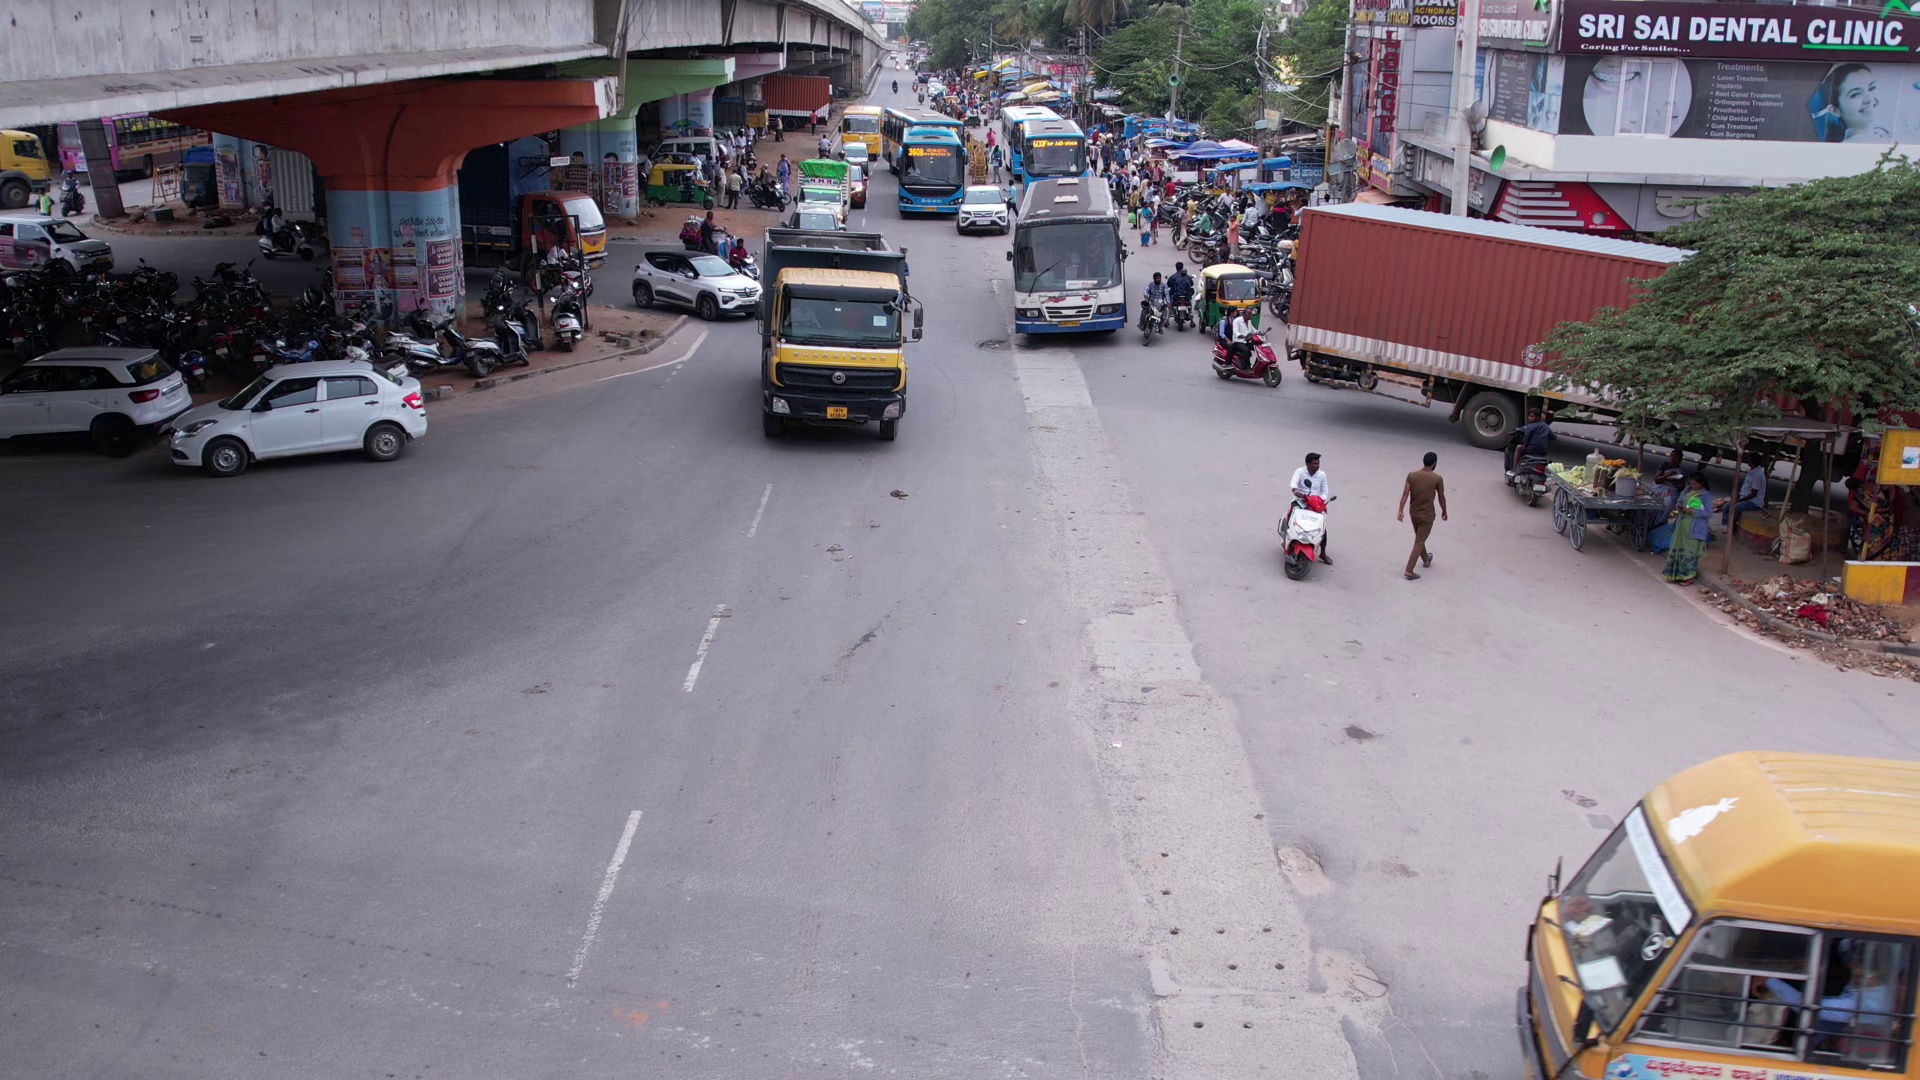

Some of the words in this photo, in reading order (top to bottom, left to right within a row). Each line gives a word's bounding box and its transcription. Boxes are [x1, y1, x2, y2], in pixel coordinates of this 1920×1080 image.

[1413, 15, 1455, 26] ROOMS
[1578, 13, 1625, 39] SRI
[1633, 14, 1680, 41] SAI
[1688, 16, 1798, 43] DENTAL
[1807, 18, 1904, 46] CLINIC
[1580, 43, 1619, 52] Caring
[1717, 62, 1765, 72] Treatments
[1379, 30, 1401, 132] LODGE
[1725, 131, 1755, 139] Surgeries
[1644, 936, 1662, 957] 2
